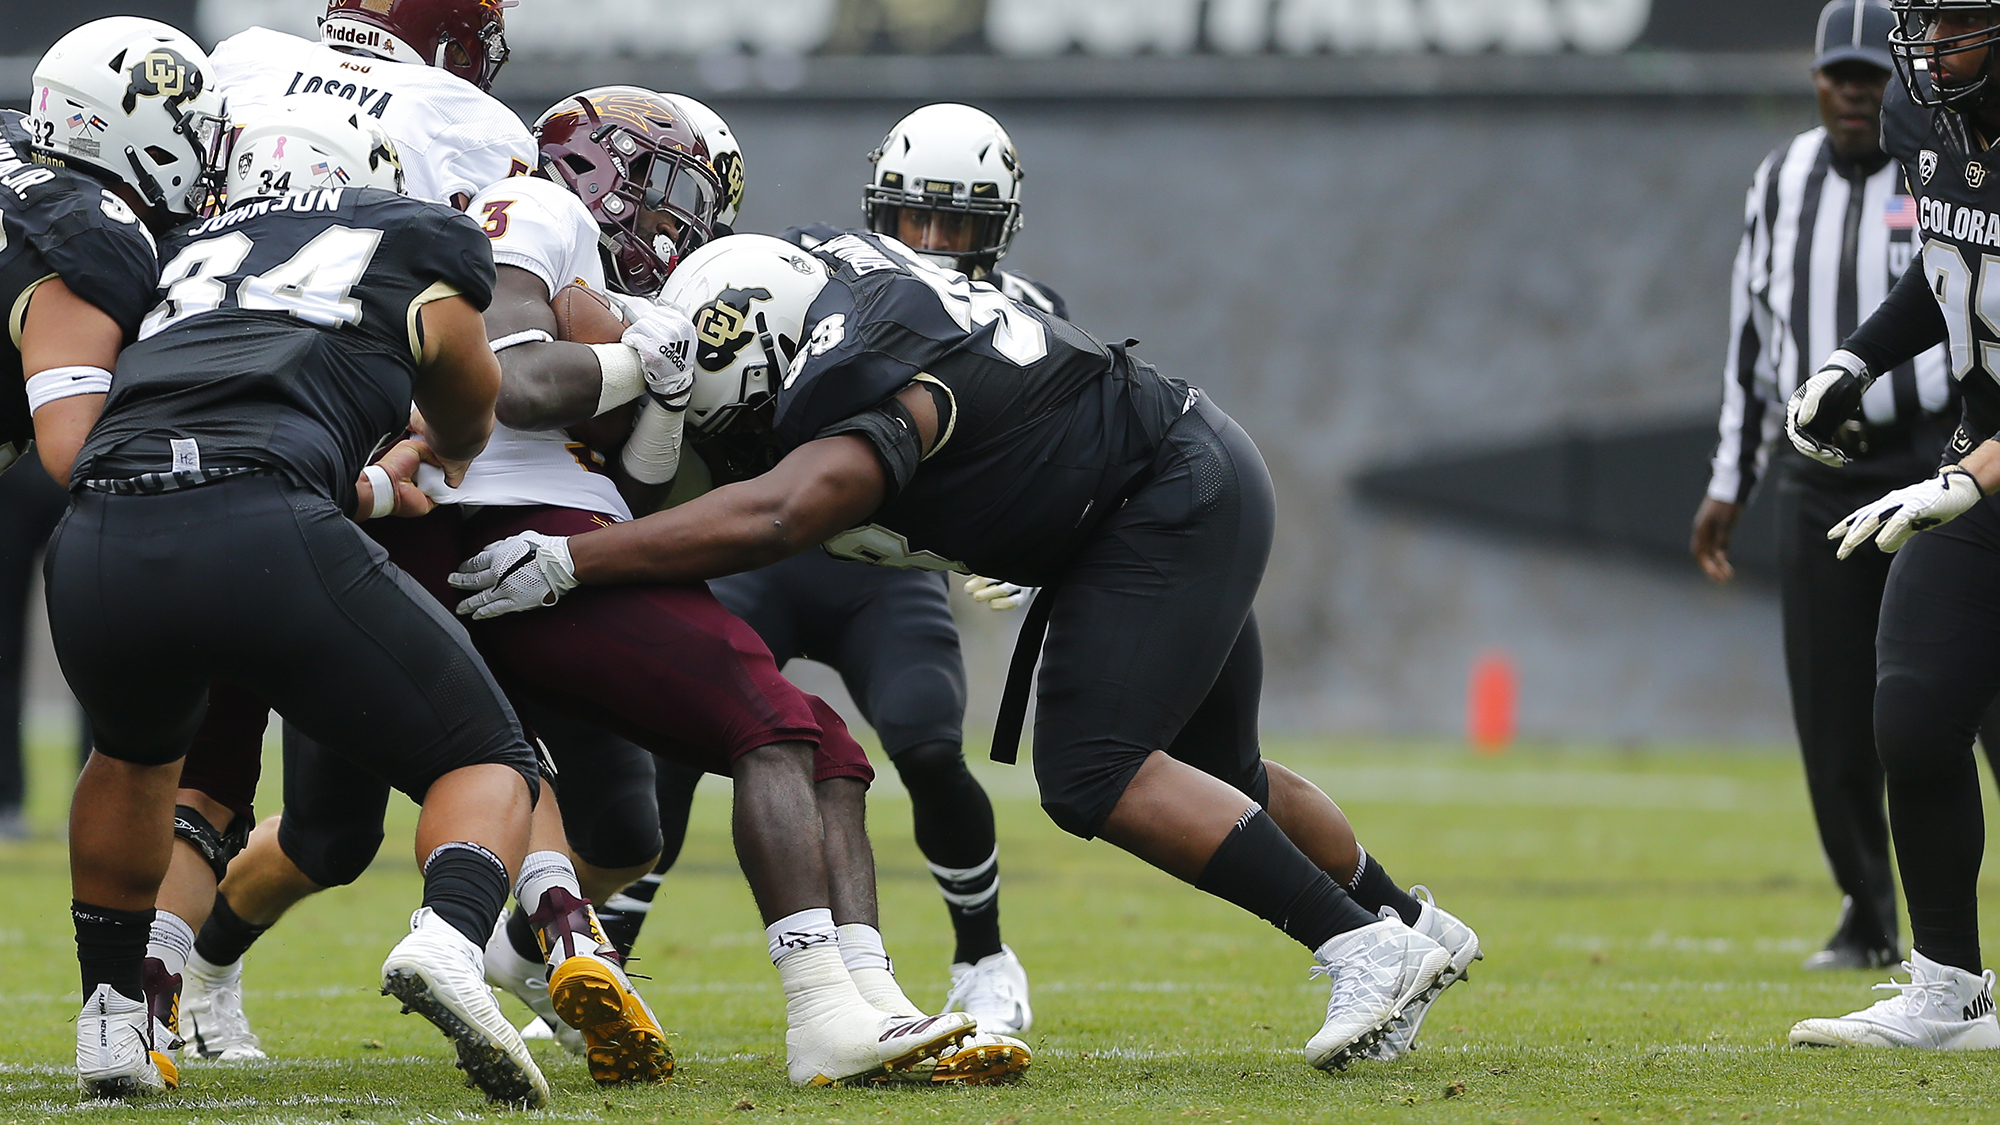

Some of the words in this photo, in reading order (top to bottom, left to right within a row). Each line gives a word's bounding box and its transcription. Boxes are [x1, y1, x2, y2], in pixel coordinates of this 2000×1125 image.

[326, 24, 380, 47] Riddell
[284, 71, 393, 119] LOSOYA
[34, 119, 55, 148] 32
[258, 170, 291, 195] 34
[188, 188, 344, 236] JOHNSON
[481, 200, 518, 240] 3
[138, 224, 385, 342] 34
[659, 344, 686, 372] adidas
